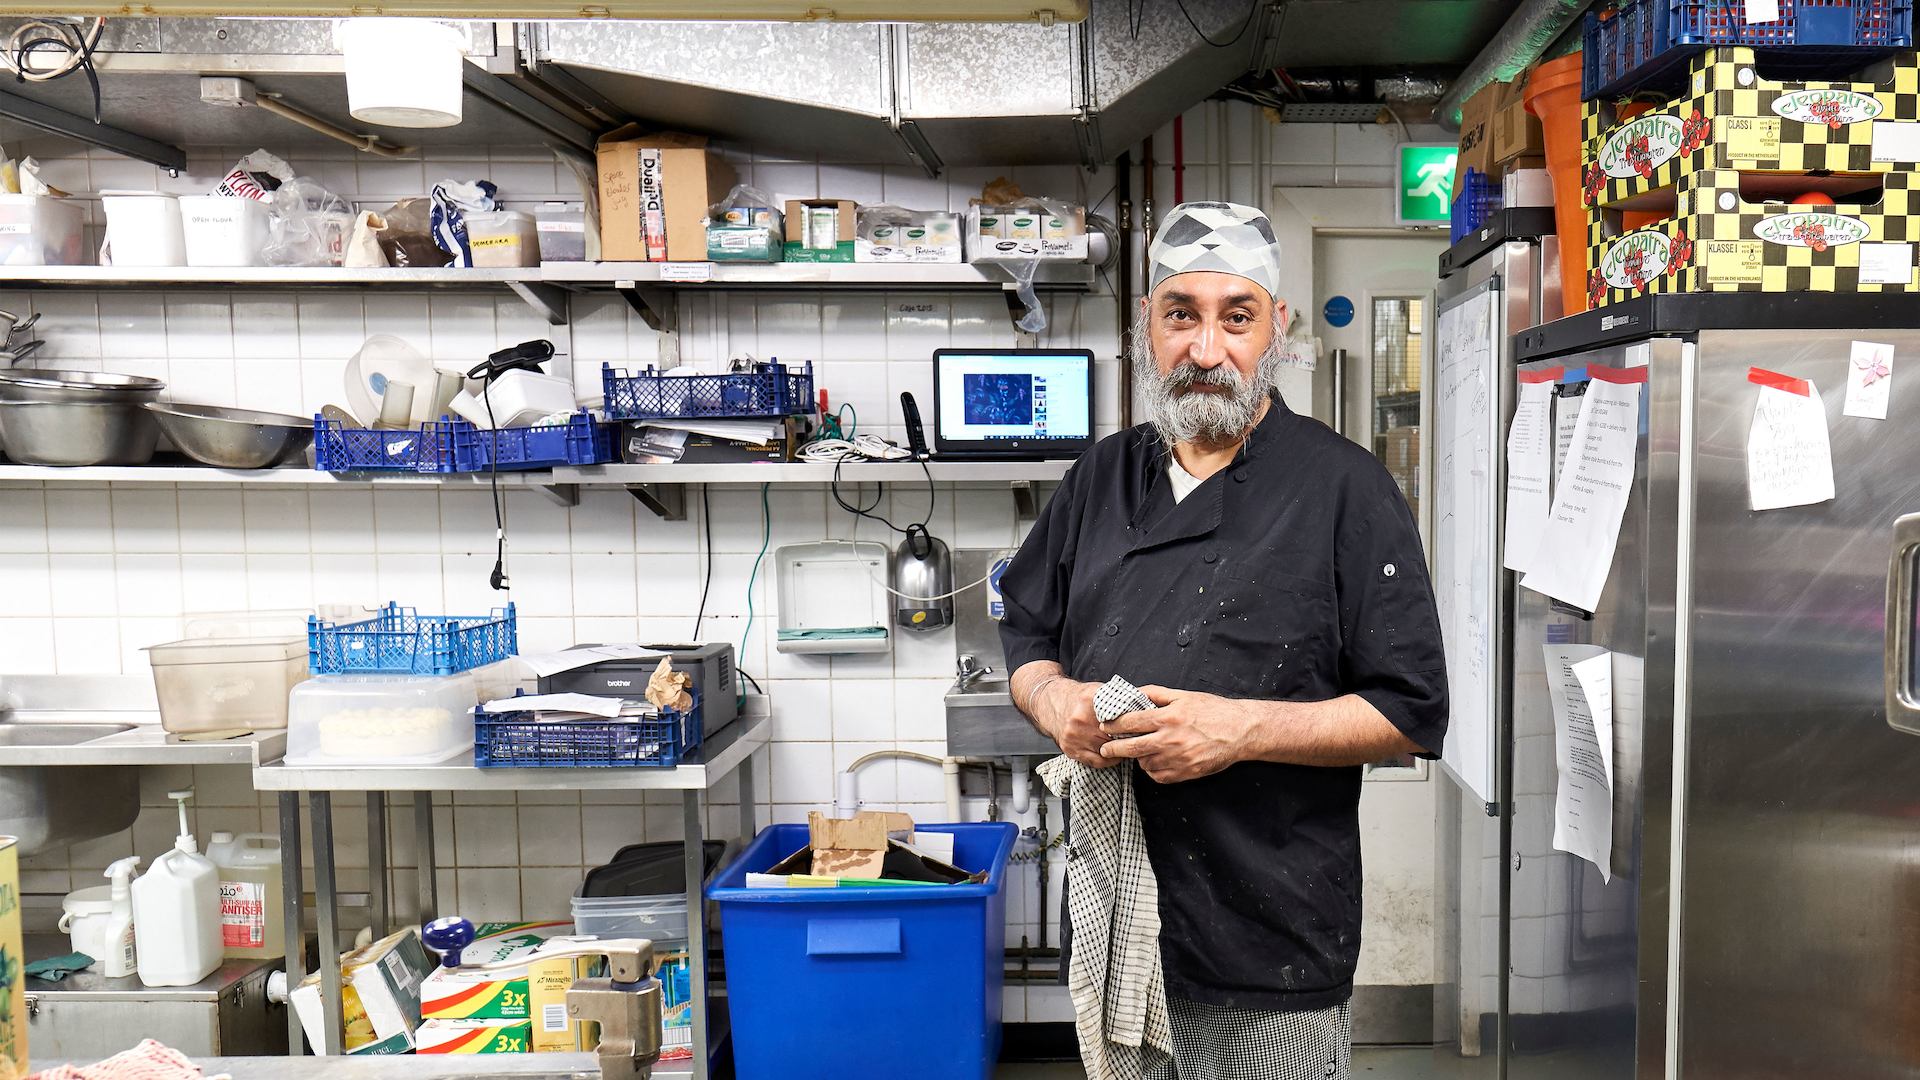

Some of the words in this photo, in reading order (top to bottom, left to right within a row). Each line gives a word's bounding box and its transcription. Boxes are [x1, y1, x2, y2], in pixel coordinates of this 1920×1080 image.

[1728, 119, 1749, 130] CLASS
[225, 169, 267, 201] PLAIN
[643, 158, 656, 196] Duali
[1708, 243, 1734, 253] KLASSE
[221, 905, 263, 916] ANITISER
[500, 989, 526, 1007] 3x
[495, 1034, 521, 1052] 3x
